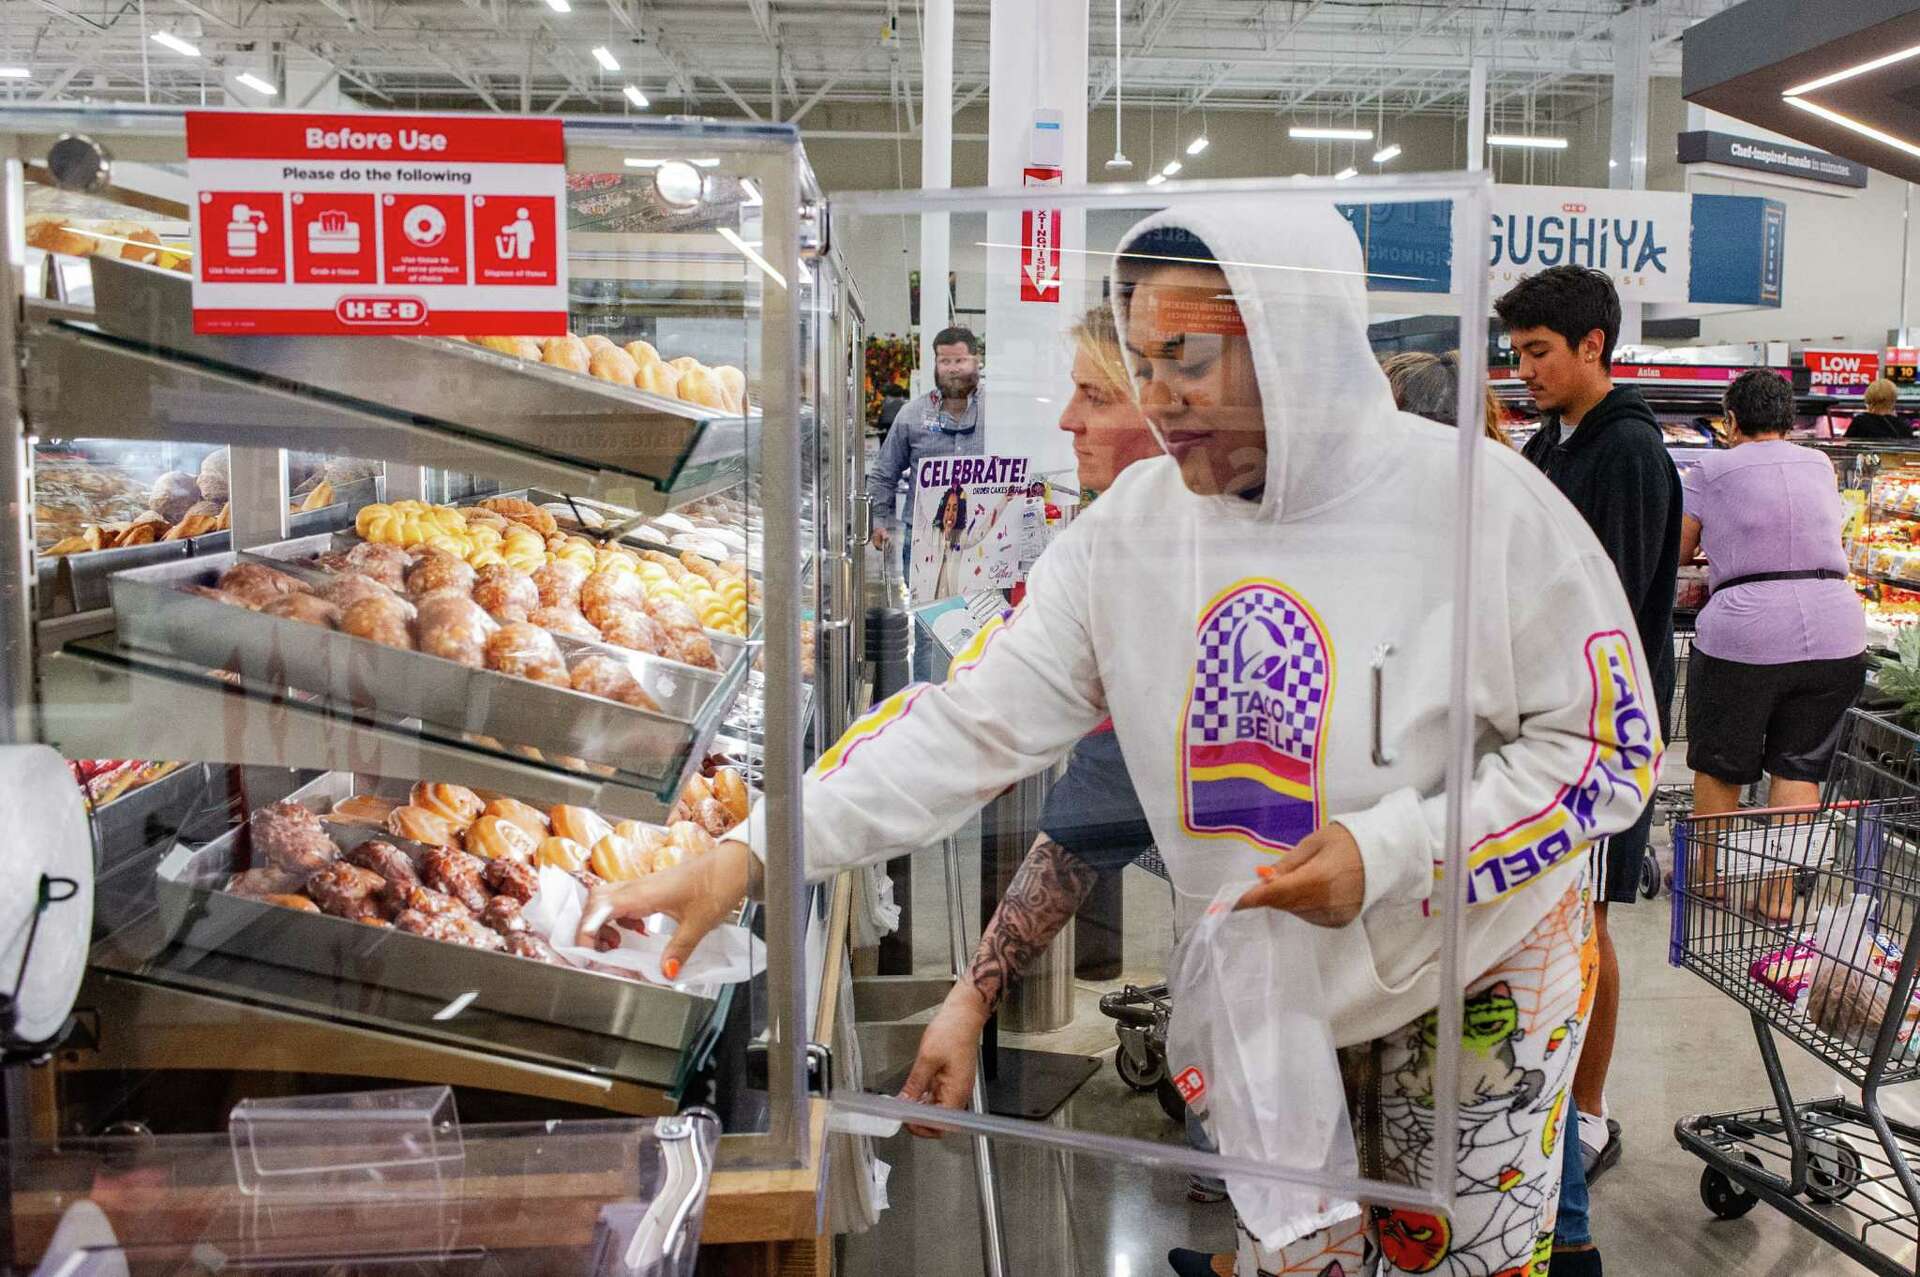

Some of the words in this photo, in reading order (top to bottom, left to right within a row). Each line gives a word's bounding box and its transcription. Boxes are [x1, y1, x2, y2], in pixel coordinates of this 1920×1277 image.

[305, 127, 393, 150] Before
[399, 129, 448, 151] Use
[1730, 143, 1787, 165] Chef-inspired
[283, 167, 334, 181] Please
[340, 167, 361, 181] do
[366, 168, 392, 182] the
[397, 169, 472, 184] following
[1035, 209, 1047, 285] XTINGISHE
[209, 267, 223, 275] Use
[224, 267, 245, 275] hand
[1637, 366, 1660, 377] Asian
[1821, 356, 1861, 372] LOW
[919, 457, 1028, 488] CELEBRATE!
[991, 486, 1008, 494] CAKES
[1230, 690, 1285, 724] TACO
[1608, 655, 1652, 770] ACO
[1236, 716, 1285, 749] BELL
